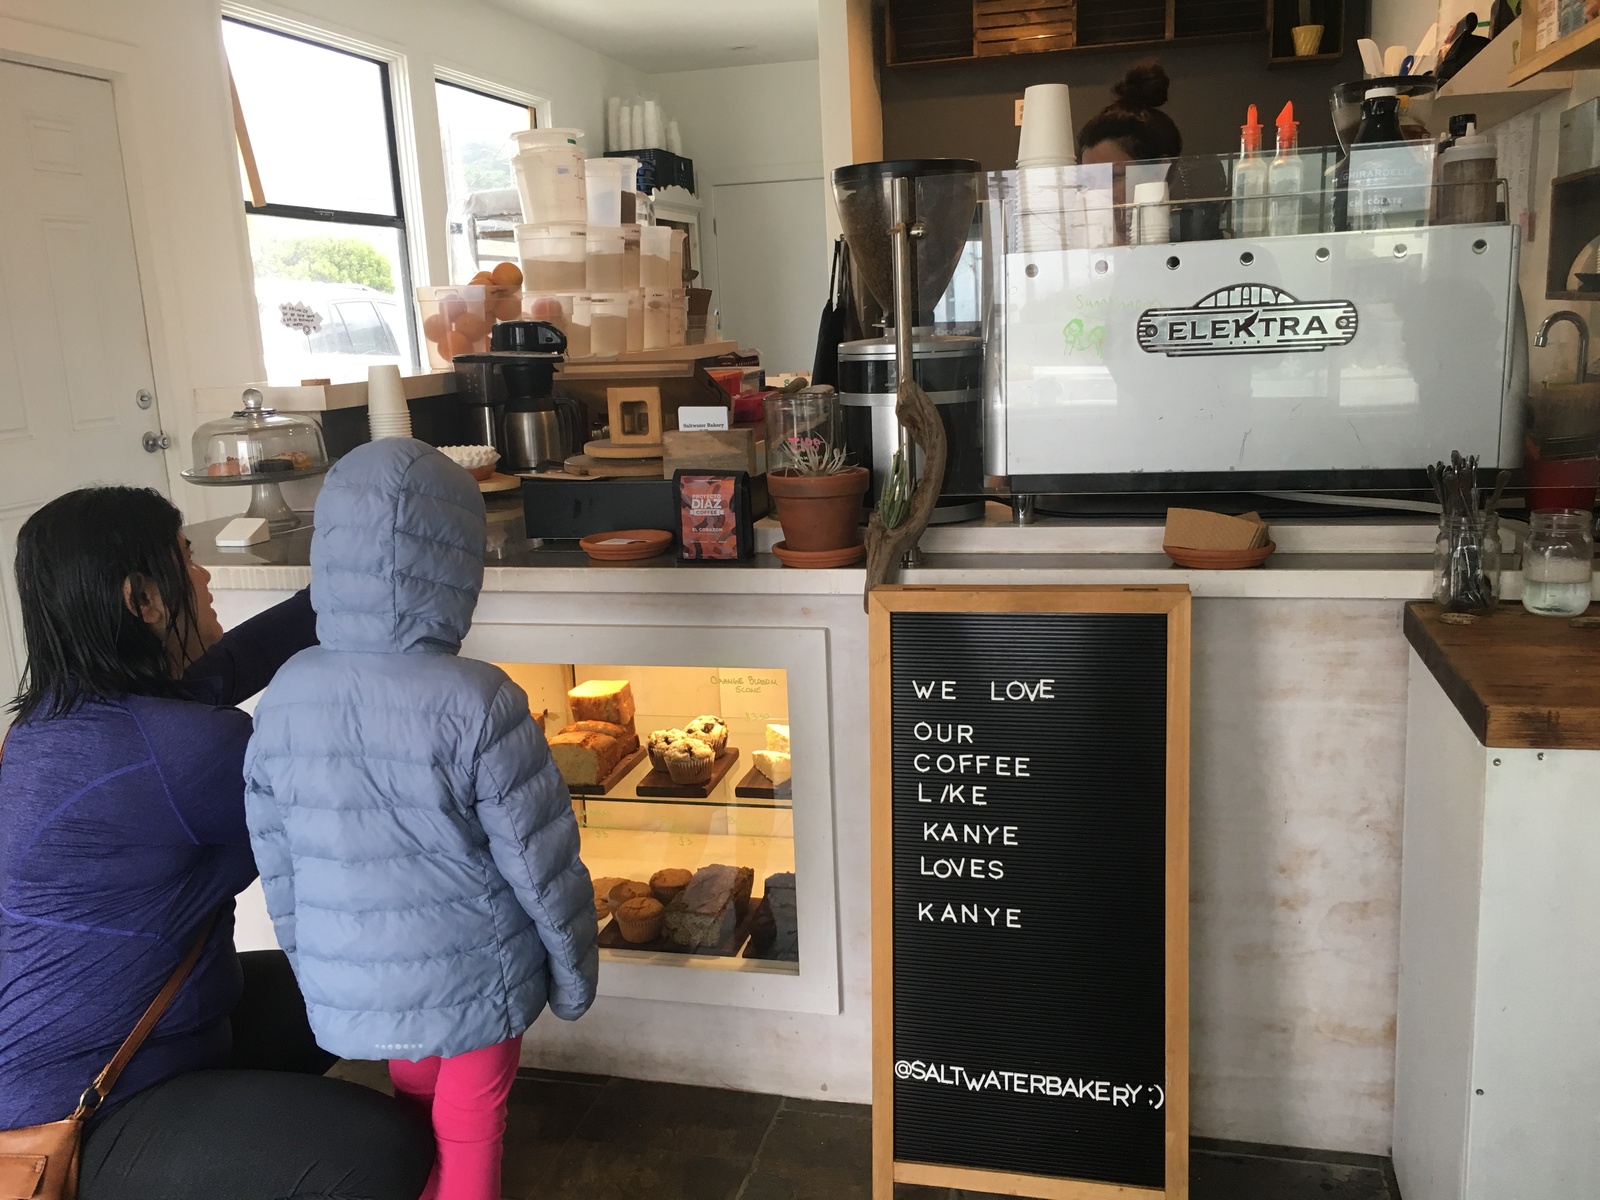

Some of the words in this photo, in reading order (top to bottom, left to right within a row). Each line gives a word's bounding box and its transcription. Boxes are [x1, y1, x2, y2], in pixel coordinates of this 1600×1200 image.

[1349, 197, 1402, 208] CHCOLATE
[1213, 285, 1282, 307] ITALY
[1168, 309, 1328, 342] ELEKTRA
[691, 499, 722, 509] DIAZ
[710, 675, 744, 686] ORANGE
[735, 685, 762, 694] SCONE
[912, 680, 956, 700] WE
[991, 679, 1055, 702] LOVE
[913, 721, 974, 744] OUR
[913, 753, 1030, 777] COFFEE
[923, 821, 1018, 846] KANYE
[920, 855, 1004, 880] LOVES
[918, 902, 1021, 928] KANYE
[894, 1059, 1143, 1108] @SALTWATERBAKERY
